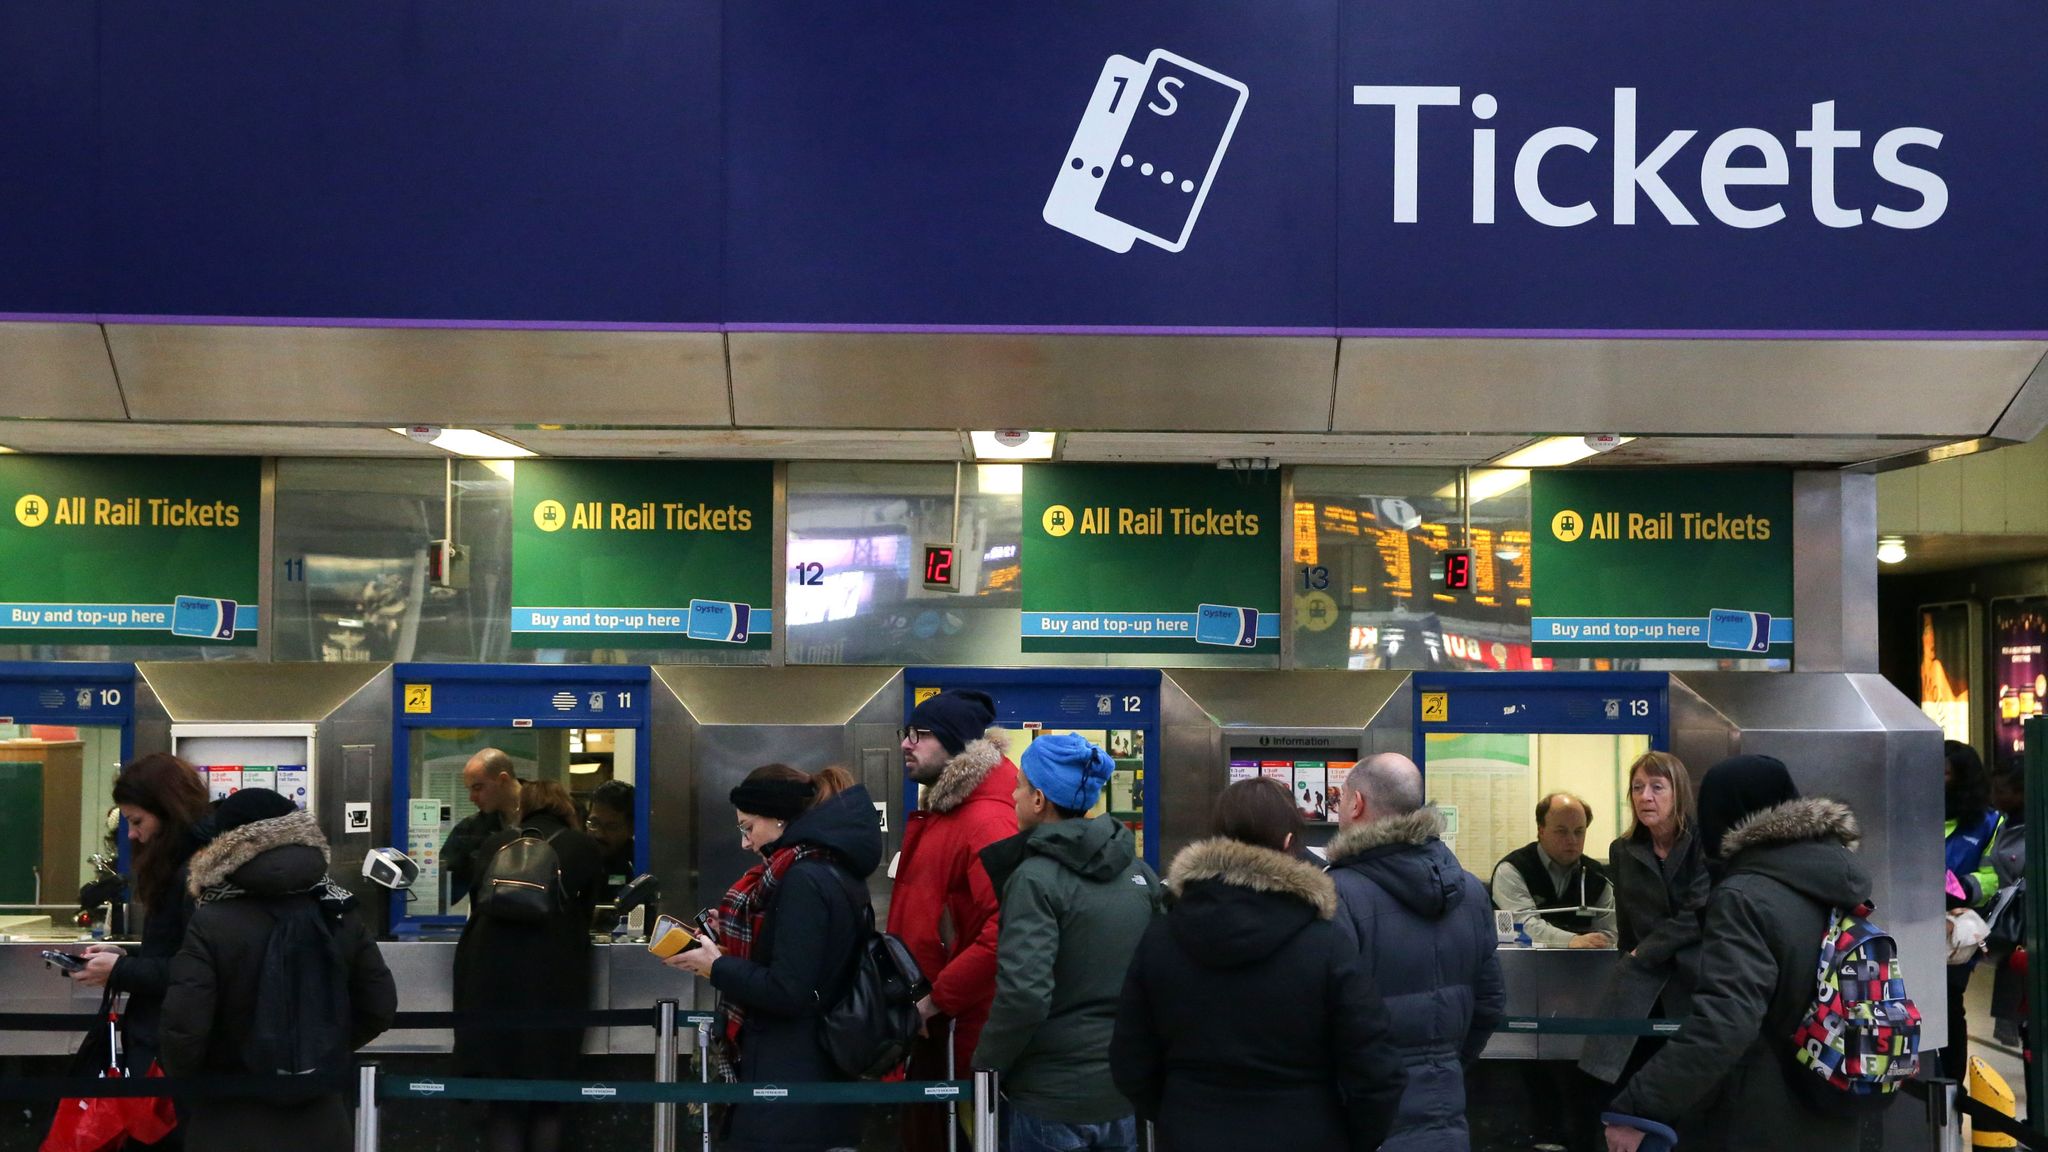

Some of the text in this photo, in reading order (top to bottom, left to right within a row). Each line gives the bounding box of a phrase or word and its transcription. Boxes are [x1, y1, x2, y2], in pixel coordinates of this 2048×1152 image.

[1108, 76, 1129, 114] 1
[1147, 76, 1185, 117] S
[1353, 85, 1949, 230] Tickets
[54, 496, 240, 527] All Rail Tickets
[571, 501, 752, 531] All Rail Tickets
[1080, 506, 1260, 536] All Rail Tickets
[1589, 511, 1770, 541] All Rail Tickets
[284, 558, 303, 582] 11
[796, 562, 824, 586] 12
[927, 550, 952, 582] 12
[1447, 556, 1468, 587] 13
[1301, 567, 1330, 591] 13
[12, 608, 165, 625] Buy and top-up here
[532, 612, 681, 631] Buy and top-up here
[1041, 617, 1189, 634] Buy and top-up here
[1551, 622, 1700, 639] Buy and top-up here
[100, 689, 121, 706] 10
[617, 692, 631, 708] 11
[1122, 695, 1141, 712] 12
[1629, 699, 1649, 716] 13
[1273, 736, 1330, 746] Information
